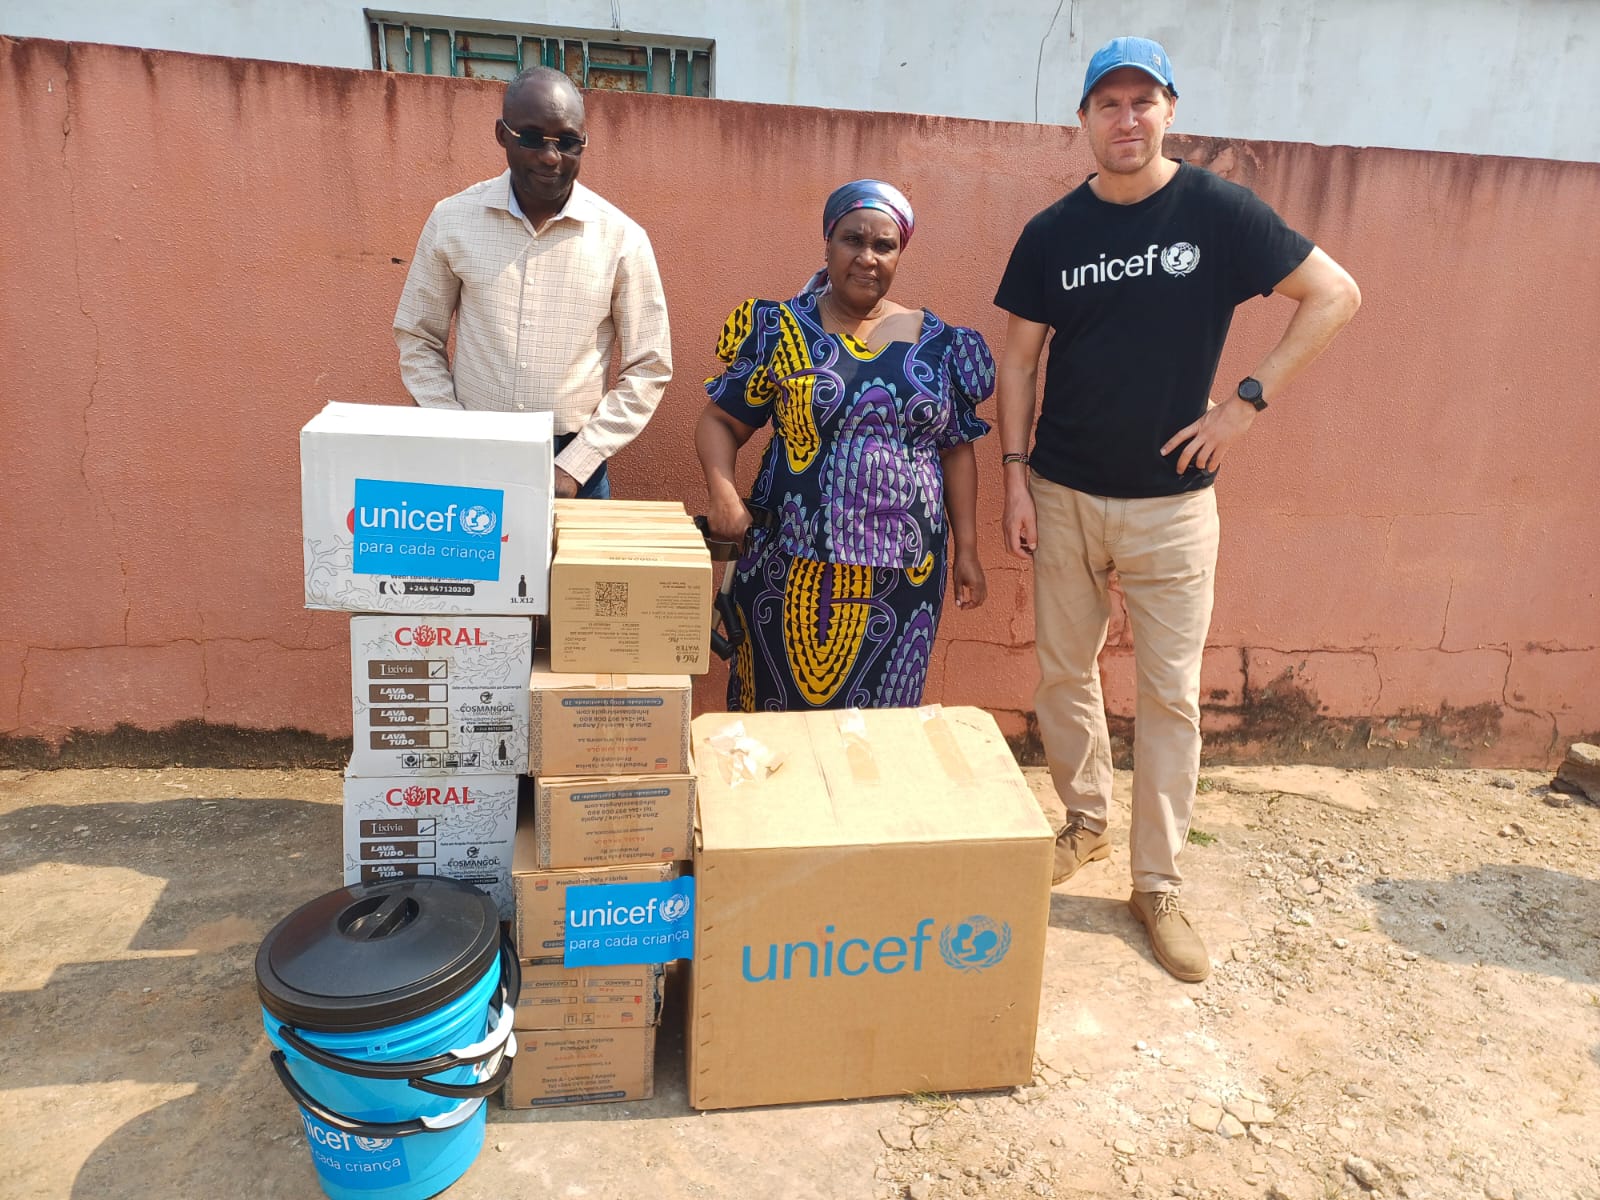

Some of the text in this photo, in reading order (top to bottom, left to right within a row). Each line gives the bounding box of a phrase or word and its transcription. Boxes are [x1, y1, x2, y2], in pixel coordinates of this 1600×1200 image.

[1061, 244, 1158, 290] unicef
[359, 501, 458, 532] unicef
[359, 541, 496, 563] para cada criança
[394, 624, 488, 647] CORAL
[388, 693, 415, 701] TUDO
[459, 705, 513, 713] COSMANGOL
[389, 715, 415, 723] TUDO
[386, 785, 475, 807] CORAL
[379, 850, 404, 858] TUDO
[448, 858, 500, 868] COSMANGOL
[371, 865, 396, 873] LAVA
[379, 870, 405, 878] TUDO
[570, 898, 657, 928] unicef
[569, 929, 690, 952] para cada criança
[742, 918, 935, 982] unicef
[345, 1158, 401, 1173] criança
